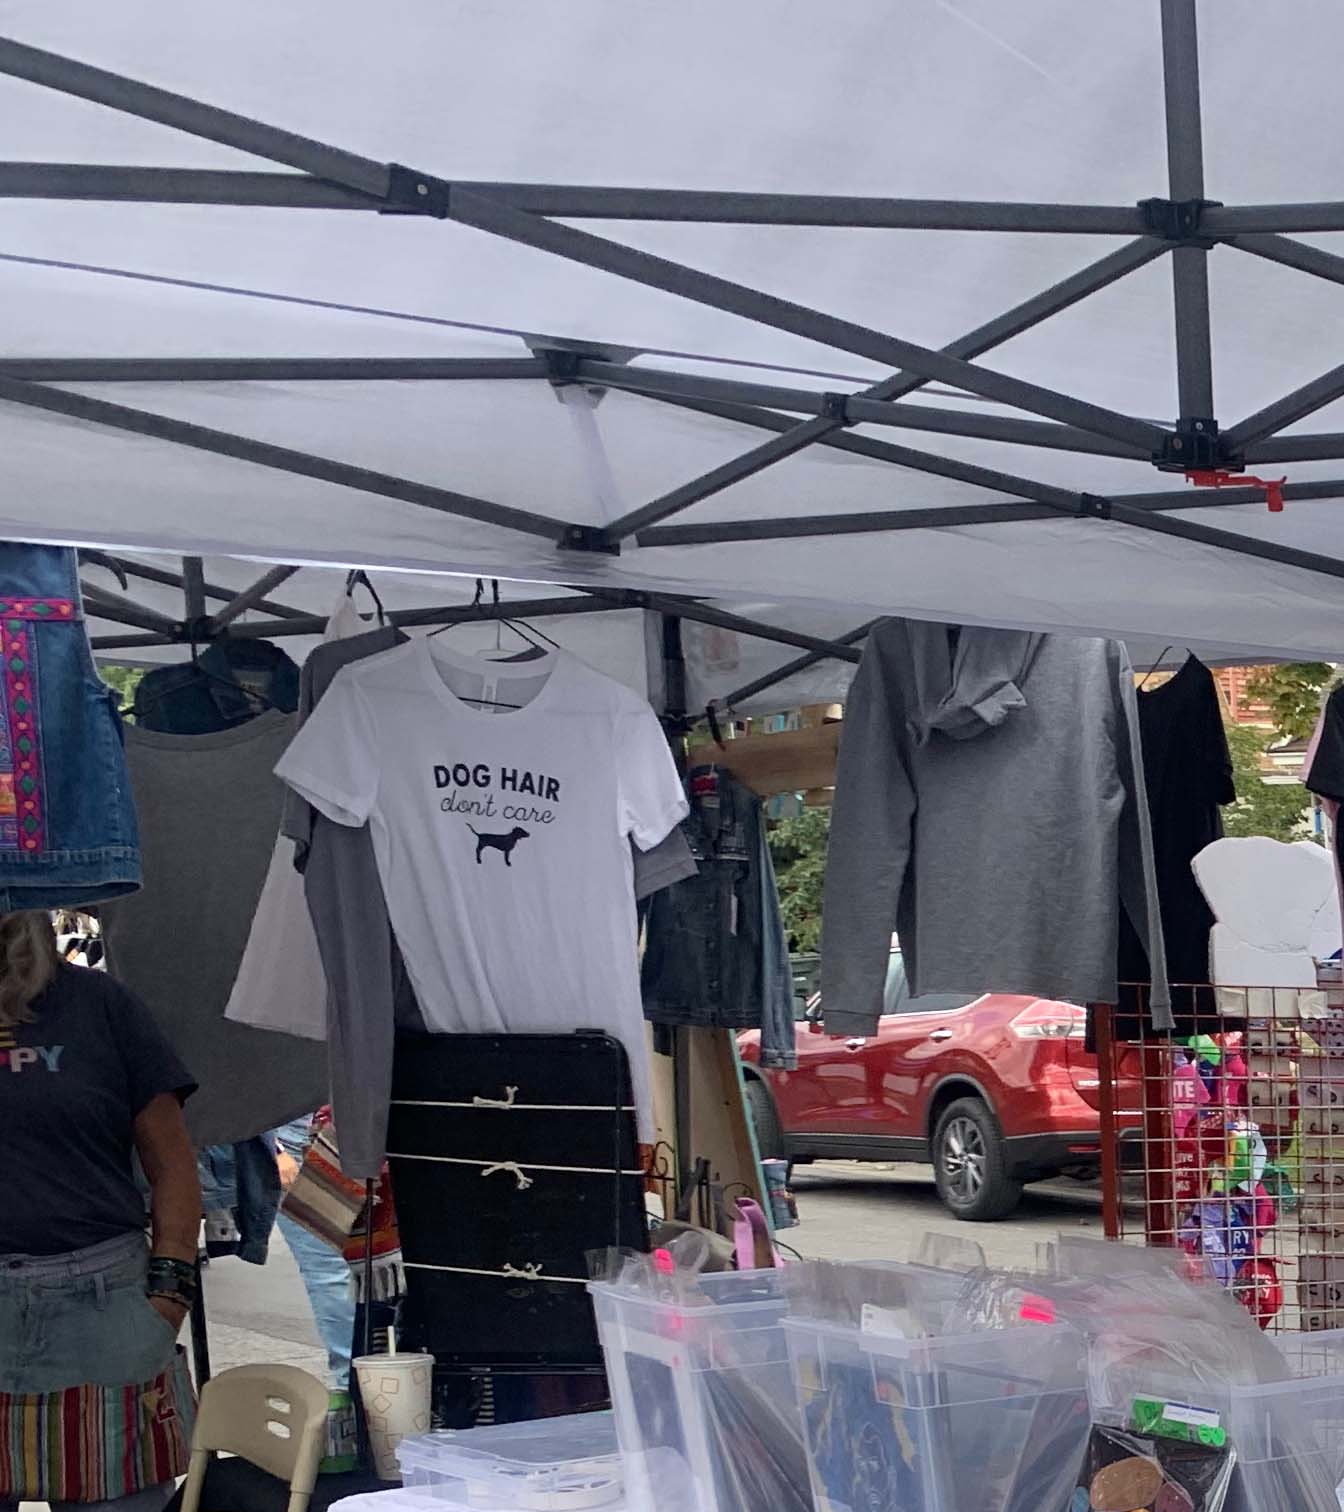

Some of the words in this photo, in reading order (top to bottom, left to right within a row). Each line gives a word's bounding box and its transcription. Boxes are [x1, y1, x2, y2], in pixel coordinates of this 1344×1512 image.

[433, 763, 491, 788] DOG
[501, 767, 560, 802] HAIR
[440, 789, 497, 817] don't
[502, 805, 556, 824] care
